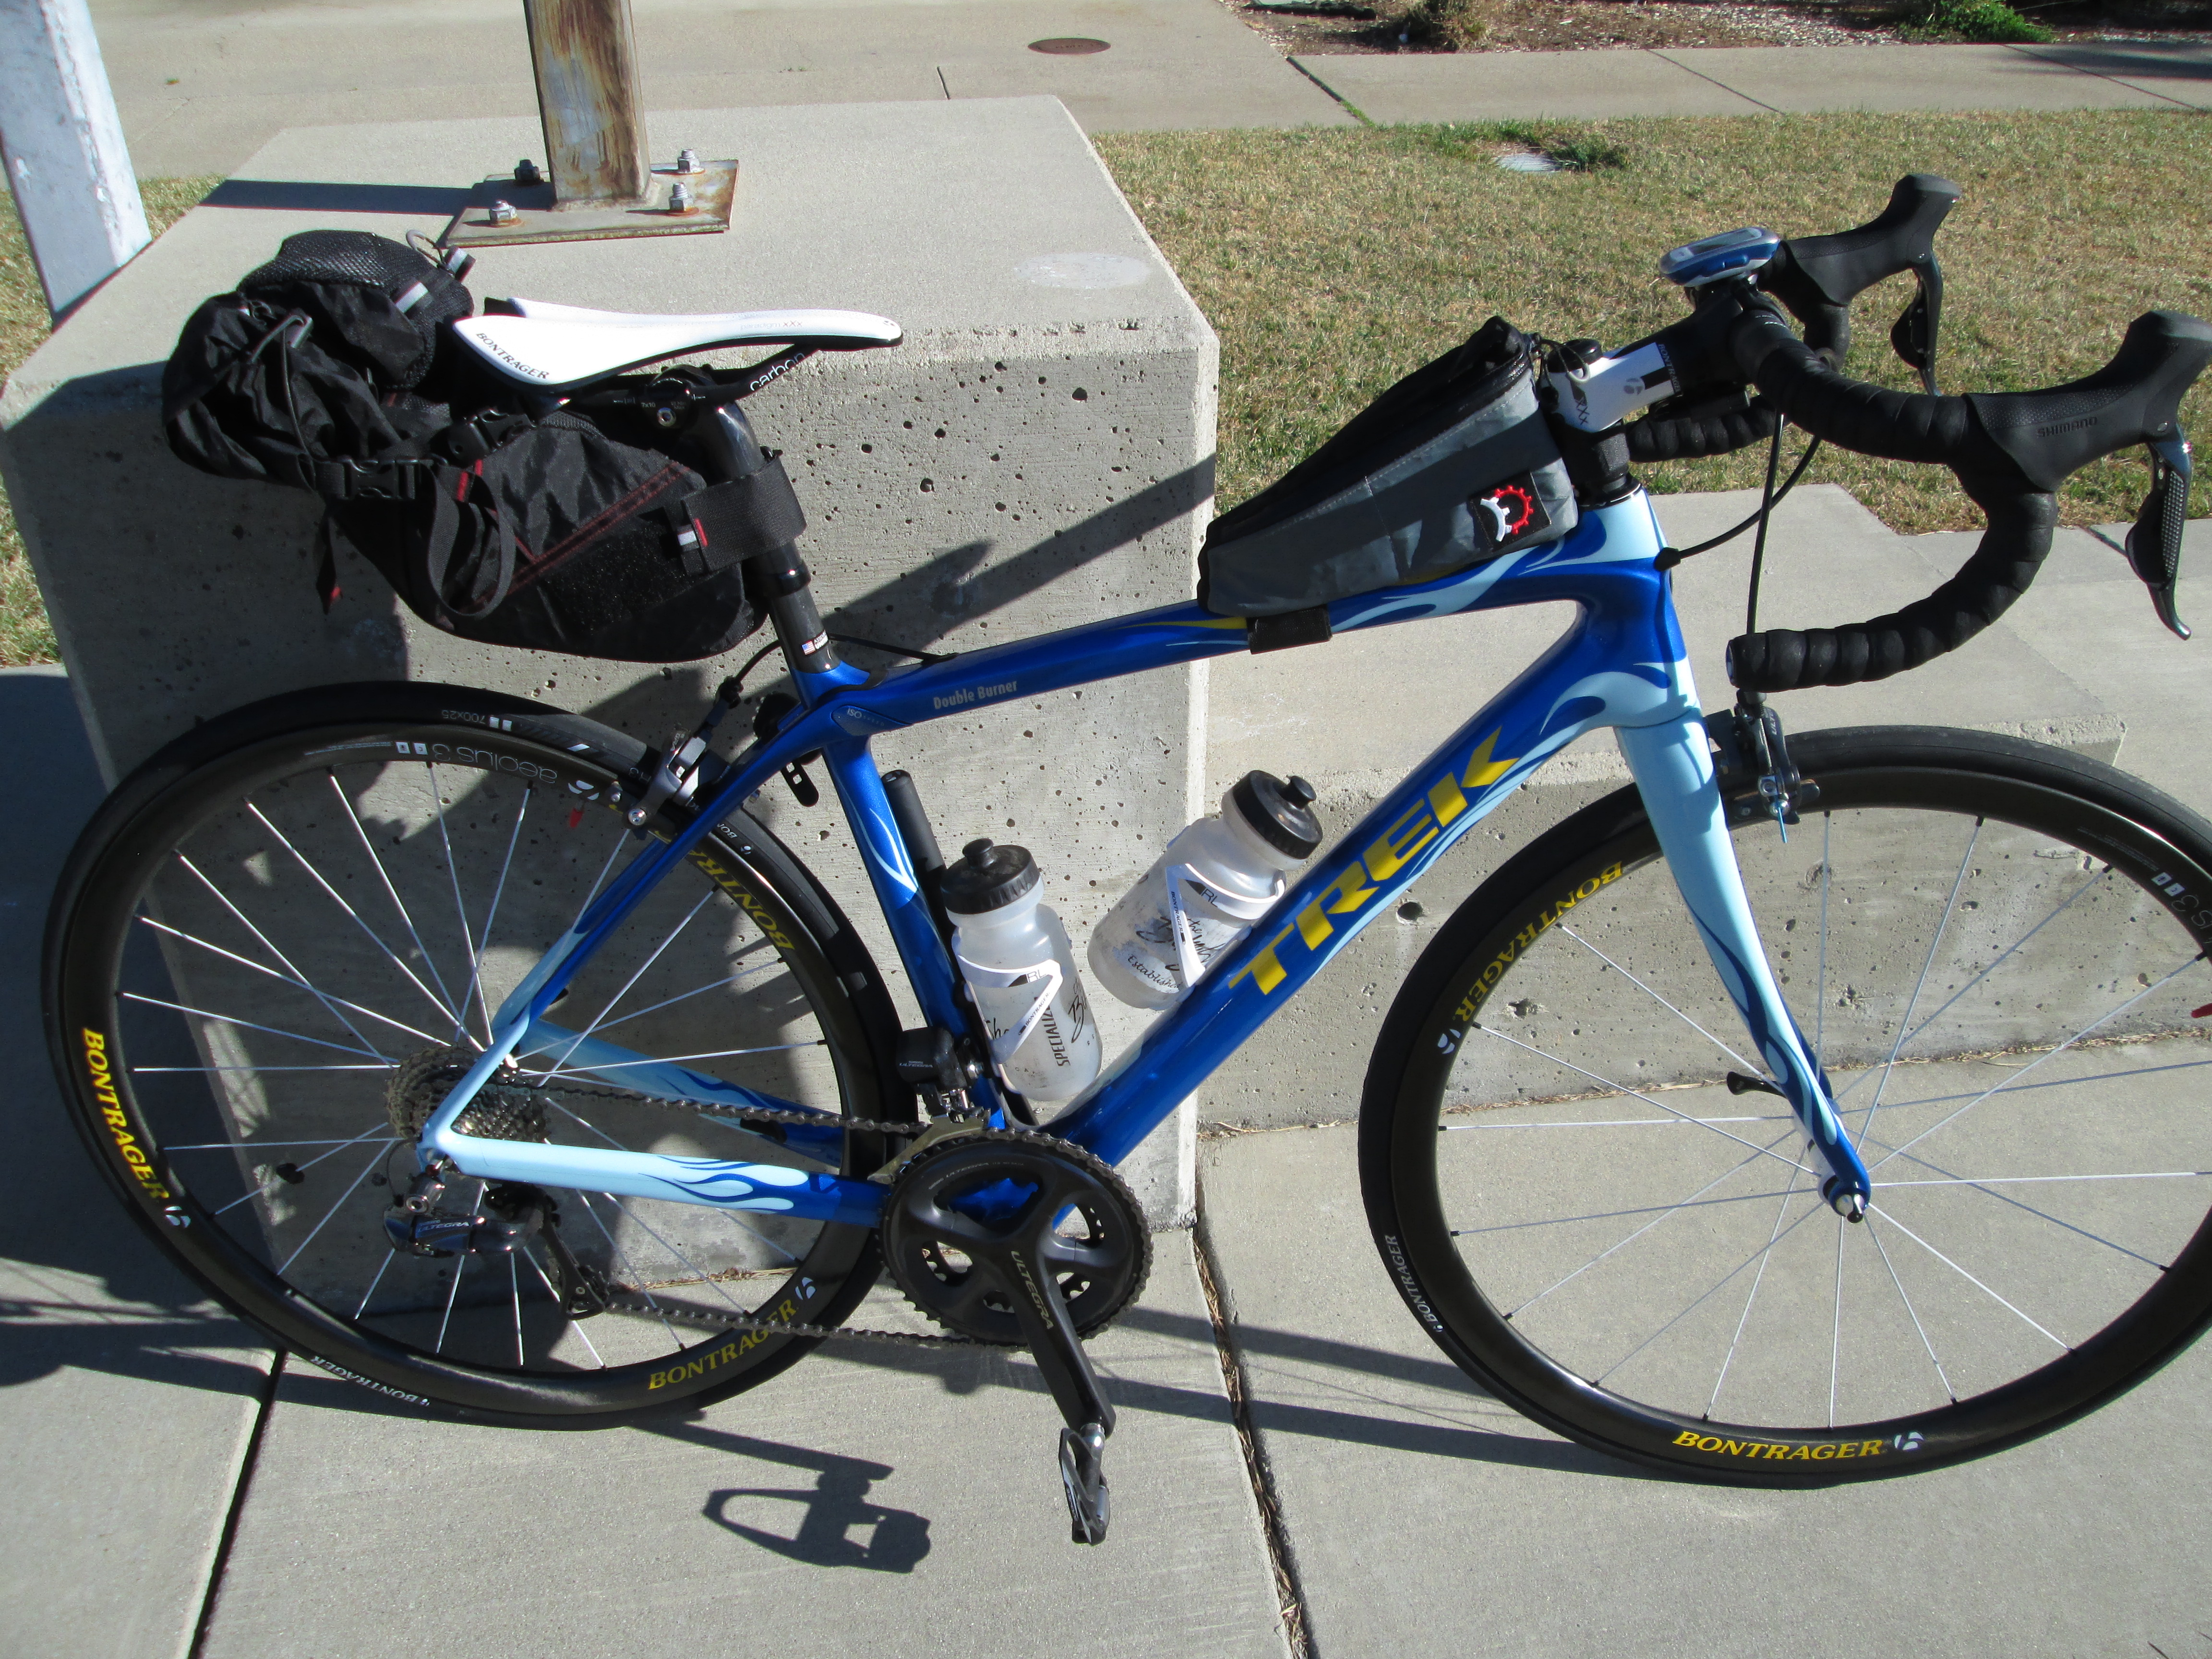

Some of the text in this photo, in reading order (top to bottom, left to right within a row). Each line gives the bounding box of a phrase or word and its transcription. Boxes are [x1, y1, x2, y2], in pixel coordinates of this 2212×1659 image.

[476, 332, 550, 379] BONTRAGER
[2037, 416, 2098, 437] SHIMANO
[933, 680, 1018, 710] Double Burner
[441, 709, 485, 724] 700x25
[432, 743, 558, 784] aeolus 3
[1228, 725, 1521, 996] TREK
[1170, 891, 1184, 933] BONTRAGER
[1201, 889, 1218, 908] RL
[1455, 861, 1623, 1022] BONTRAGER
[1026, 969, 1047, 983] RL
[1024, 992, 1050, 1026] BONTRAGER
[1037, 1002, 1071, 1067] SPECIALIZ
[83, 1027, 170, 1199] BONTRAGER
[1010, 1250, 1054, 1329] ULTEGRA
[1384, 1235, 1439, 1322] BONTRAGER
[311, 1355, 419, 1403] BONTRAGER
[1671, 1431, 1884, 1460] BONTRAGER
